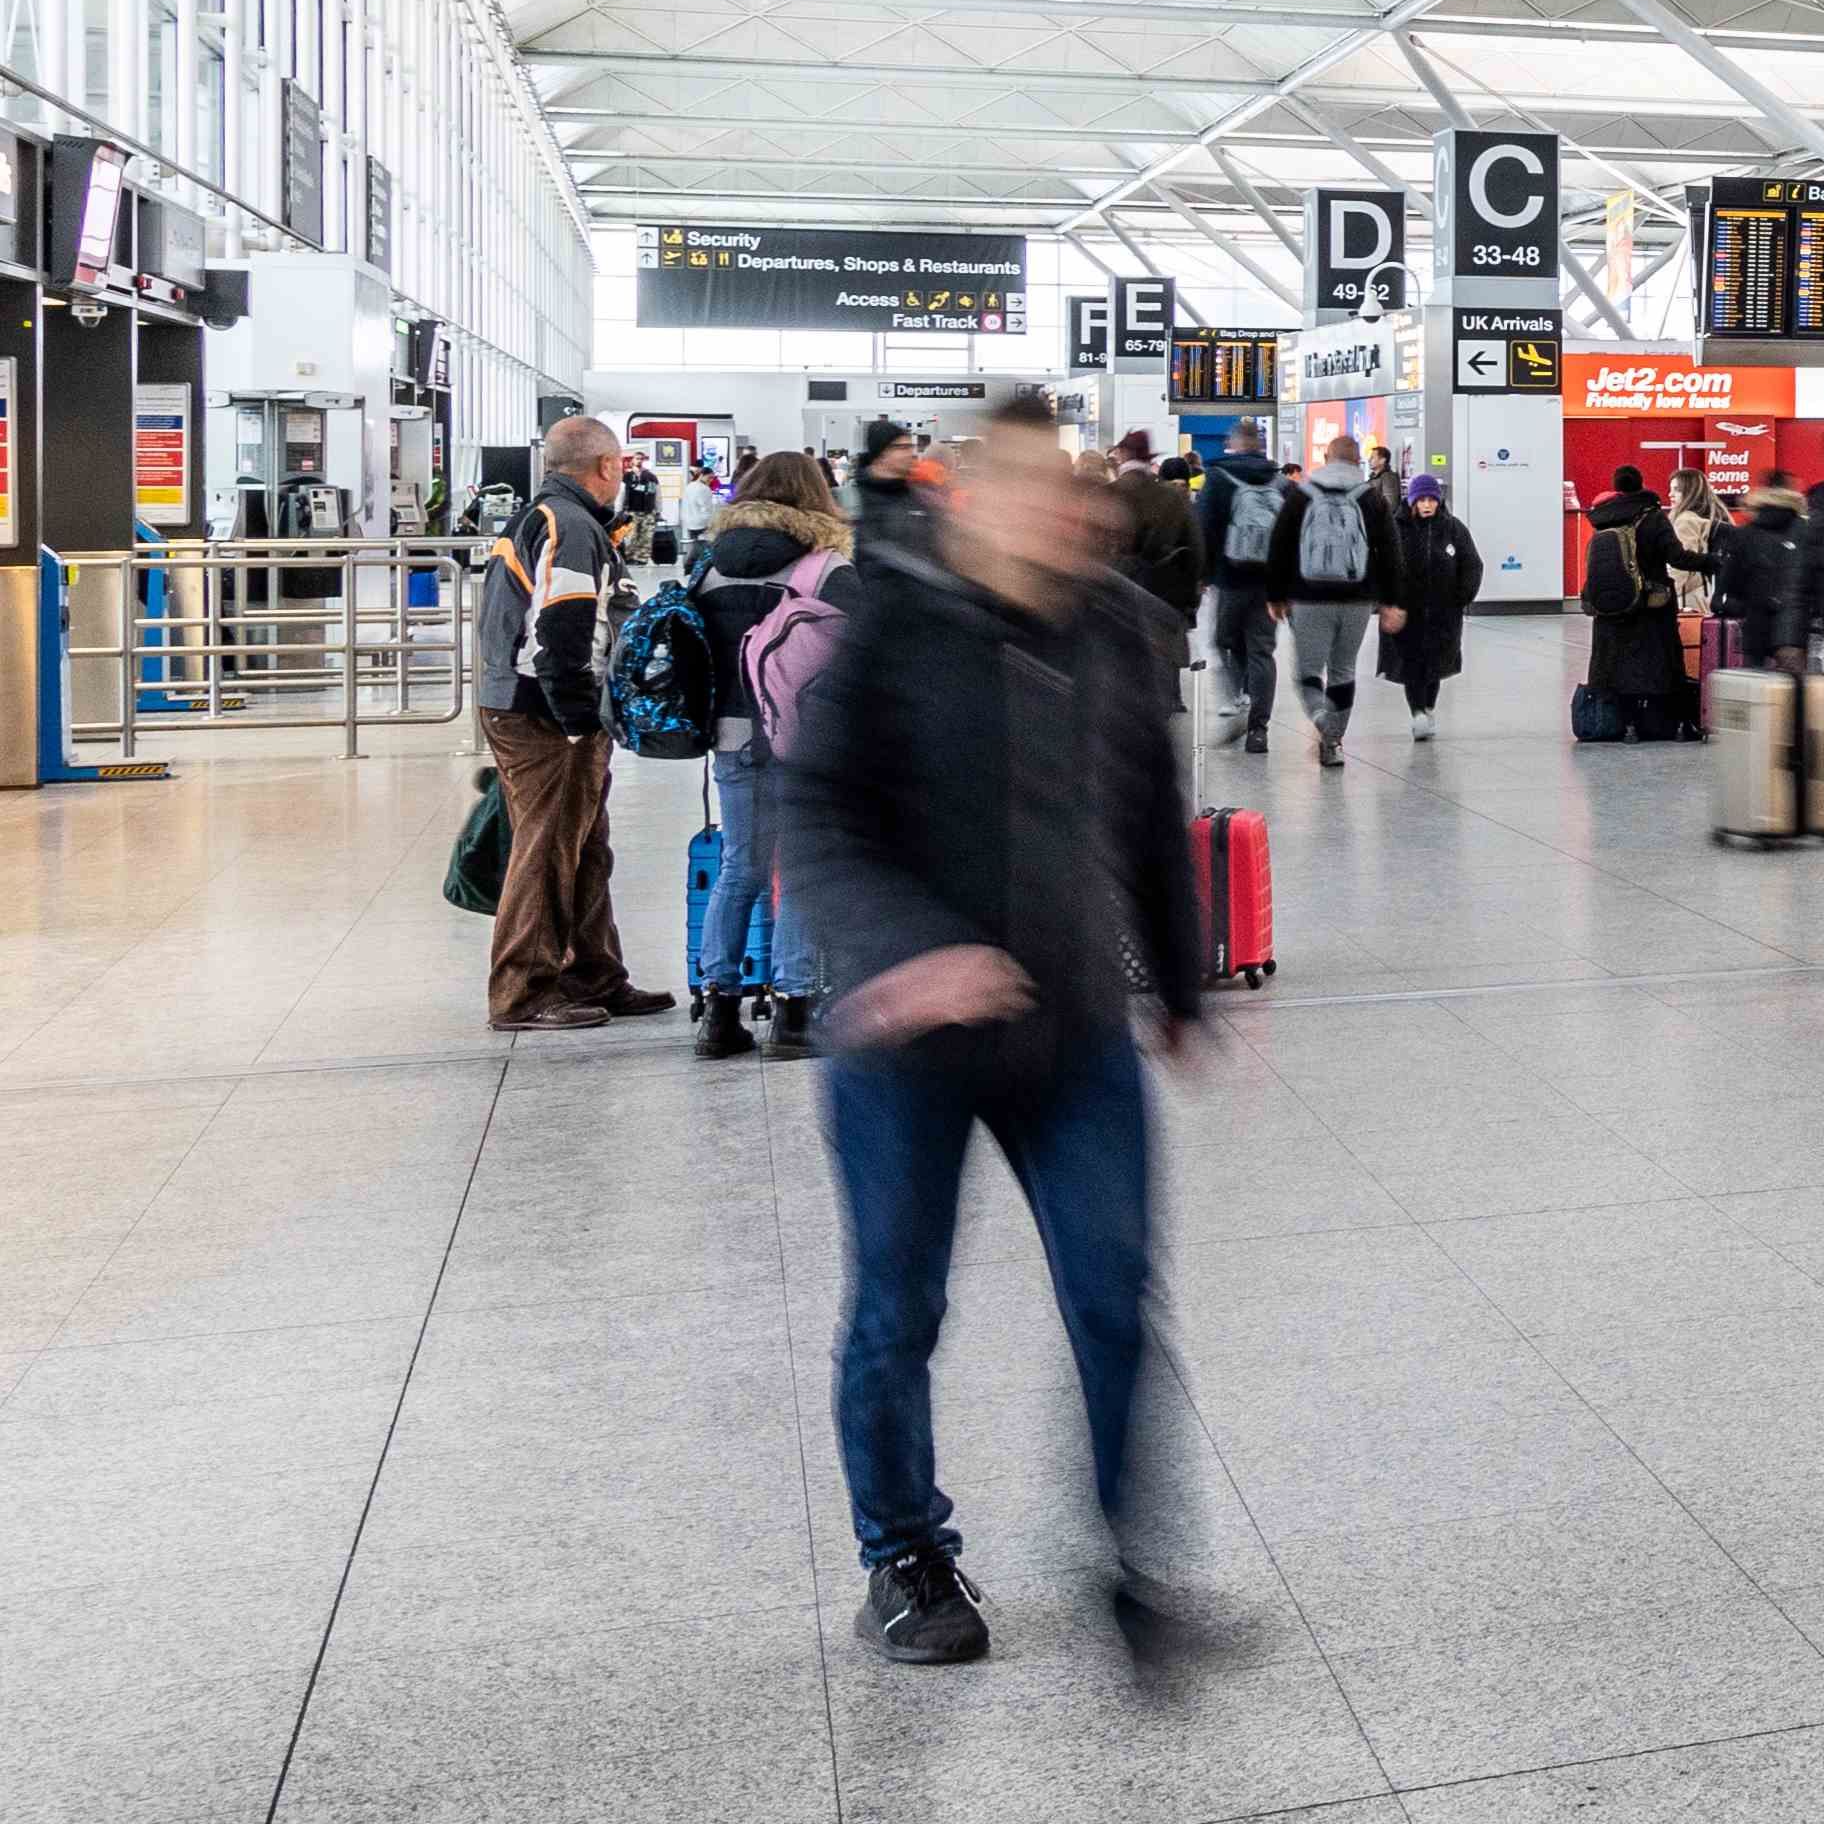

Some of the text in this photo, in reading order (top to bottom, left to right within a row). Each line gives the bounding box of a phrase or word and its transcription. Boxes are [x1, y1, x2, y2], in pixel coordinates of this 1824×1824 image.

[1469, 144, 1545, 229] C
[687, 232, 762, 250] Security
[1330, 200, 1393, 270] D
[1473, 245, 1540, 265] 33-48
[738, 254, 1021, 275] Departures, Shops & Restaurants
[836, 292, 899, 307] Access
[1126, 283, 1165, 331] E
[892, 314, 978, 329] Fast Track
[1462, 315, 1553, 332] UK Arrivals
[1125, 340, 1165, 352] 65-79
[1078, 352, 1107, 363] 81-9
[1586, 367, 1733, 393] Jet2.com
[897, 385, 969, 397] Departures
[1585, 393, 1731, 411] Friendly low fares
[1708, 450, 1749, 466] Need
[1708, 469, 1749, 482] some
